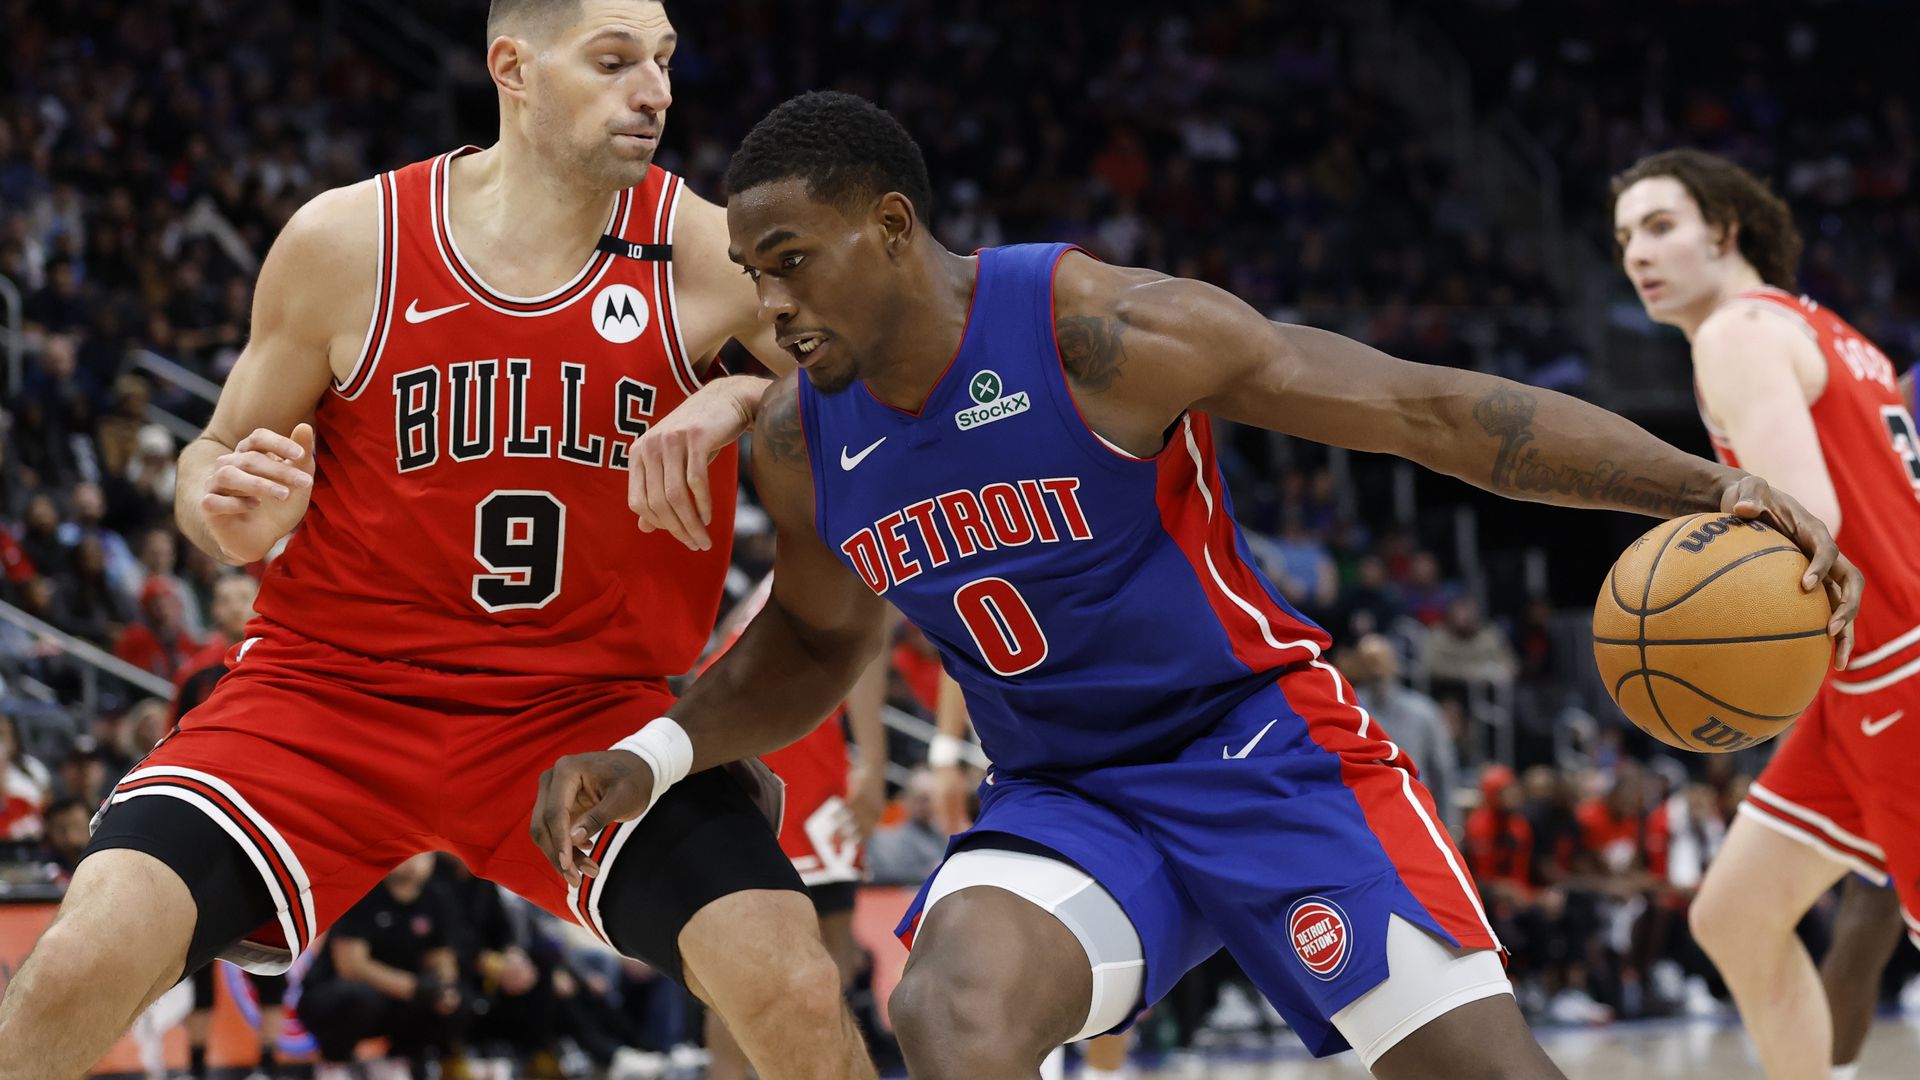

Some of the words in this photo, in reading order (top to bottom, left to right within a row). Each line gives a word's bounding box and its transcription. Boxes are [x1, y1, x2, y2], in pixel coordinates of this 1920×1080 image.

[627, 243, 643, 259] 10
[393, 357, 657, 473] BULLS
[958, 394, 1028, 427] StockX
[471, 489, 567, 613] 9
[841, 477, 1093, 596] DETROIT
[953, 577, 1049, 676] 0
[1296, 917, 1333, 946] DETROIT
[1302, 929, 1338, 958] PISTONS
